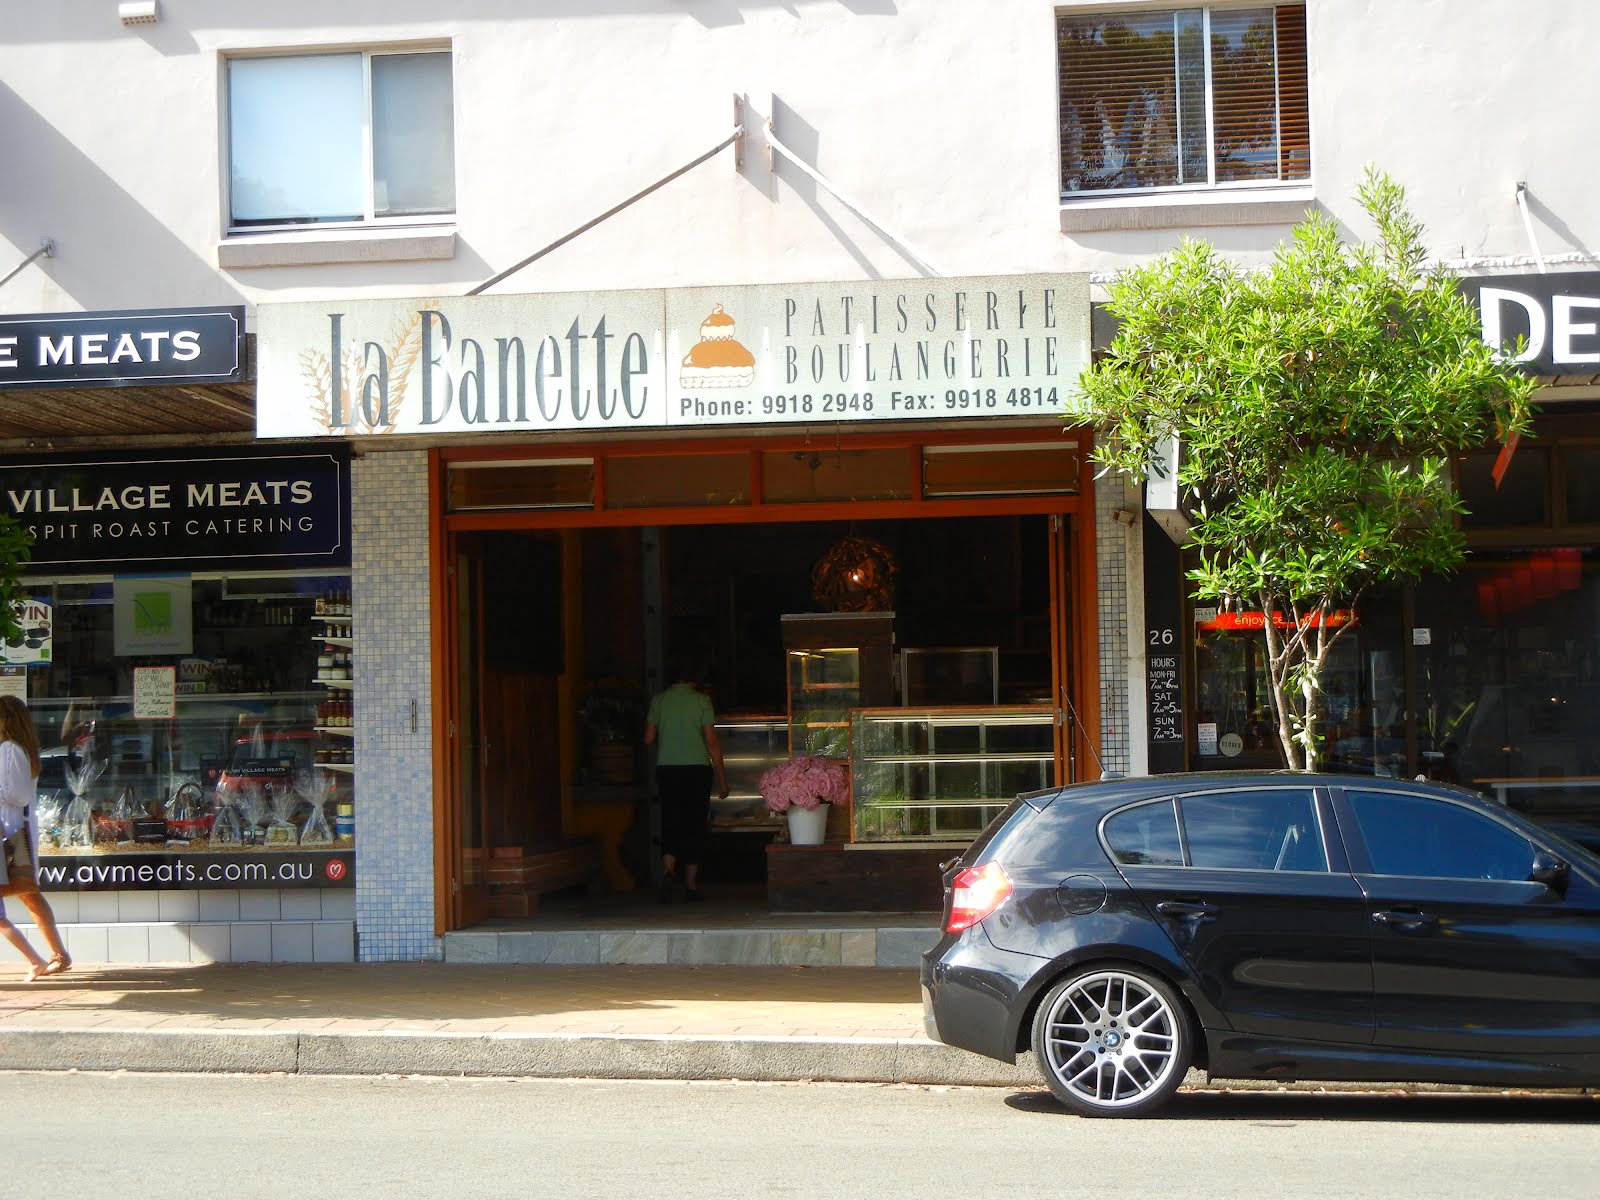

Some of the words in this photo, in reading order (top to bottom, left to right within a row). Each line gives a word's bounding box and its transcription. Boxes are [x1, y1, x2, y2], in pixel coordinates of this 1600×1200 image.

[785, 289, 1057, 337] PATISSERIE
[38, 330, 201, 367] MEATS
[327, 313, 390, 427] La
[417, 310, 648, 425] Banette
[785, 337, 1058, 384] BOULANGERIE
[680, 397, 753, 417] Phone:
[762, 394, 813, 414] 9918
[822, 393, 874, 413] 2948
[891, 391, 935, 411] Fax:
[945, 388, 997, 409] 9918
[1006, 387, 1059, 407] 4814
[8, 485, 171, 514] VILLAGE
[187, 480, 313, 508] MEATS
[29, 524, 78, 540] SPIT
[93, 521, 171, 538] ROAST
[186, 517, 314, 536] CATERING
[1234, 615, 1264, 626] enjoy
[1150, 629, 1173, 645] 26
[182, 664, 211, 674] WIN
[1151, 657, 1176, 668] HOURS
[1150, 670, 1176, 679] MON-FRI
[1154, 692, 1171, 701] SAT
[1155, 717, 1174, 725] SUN
